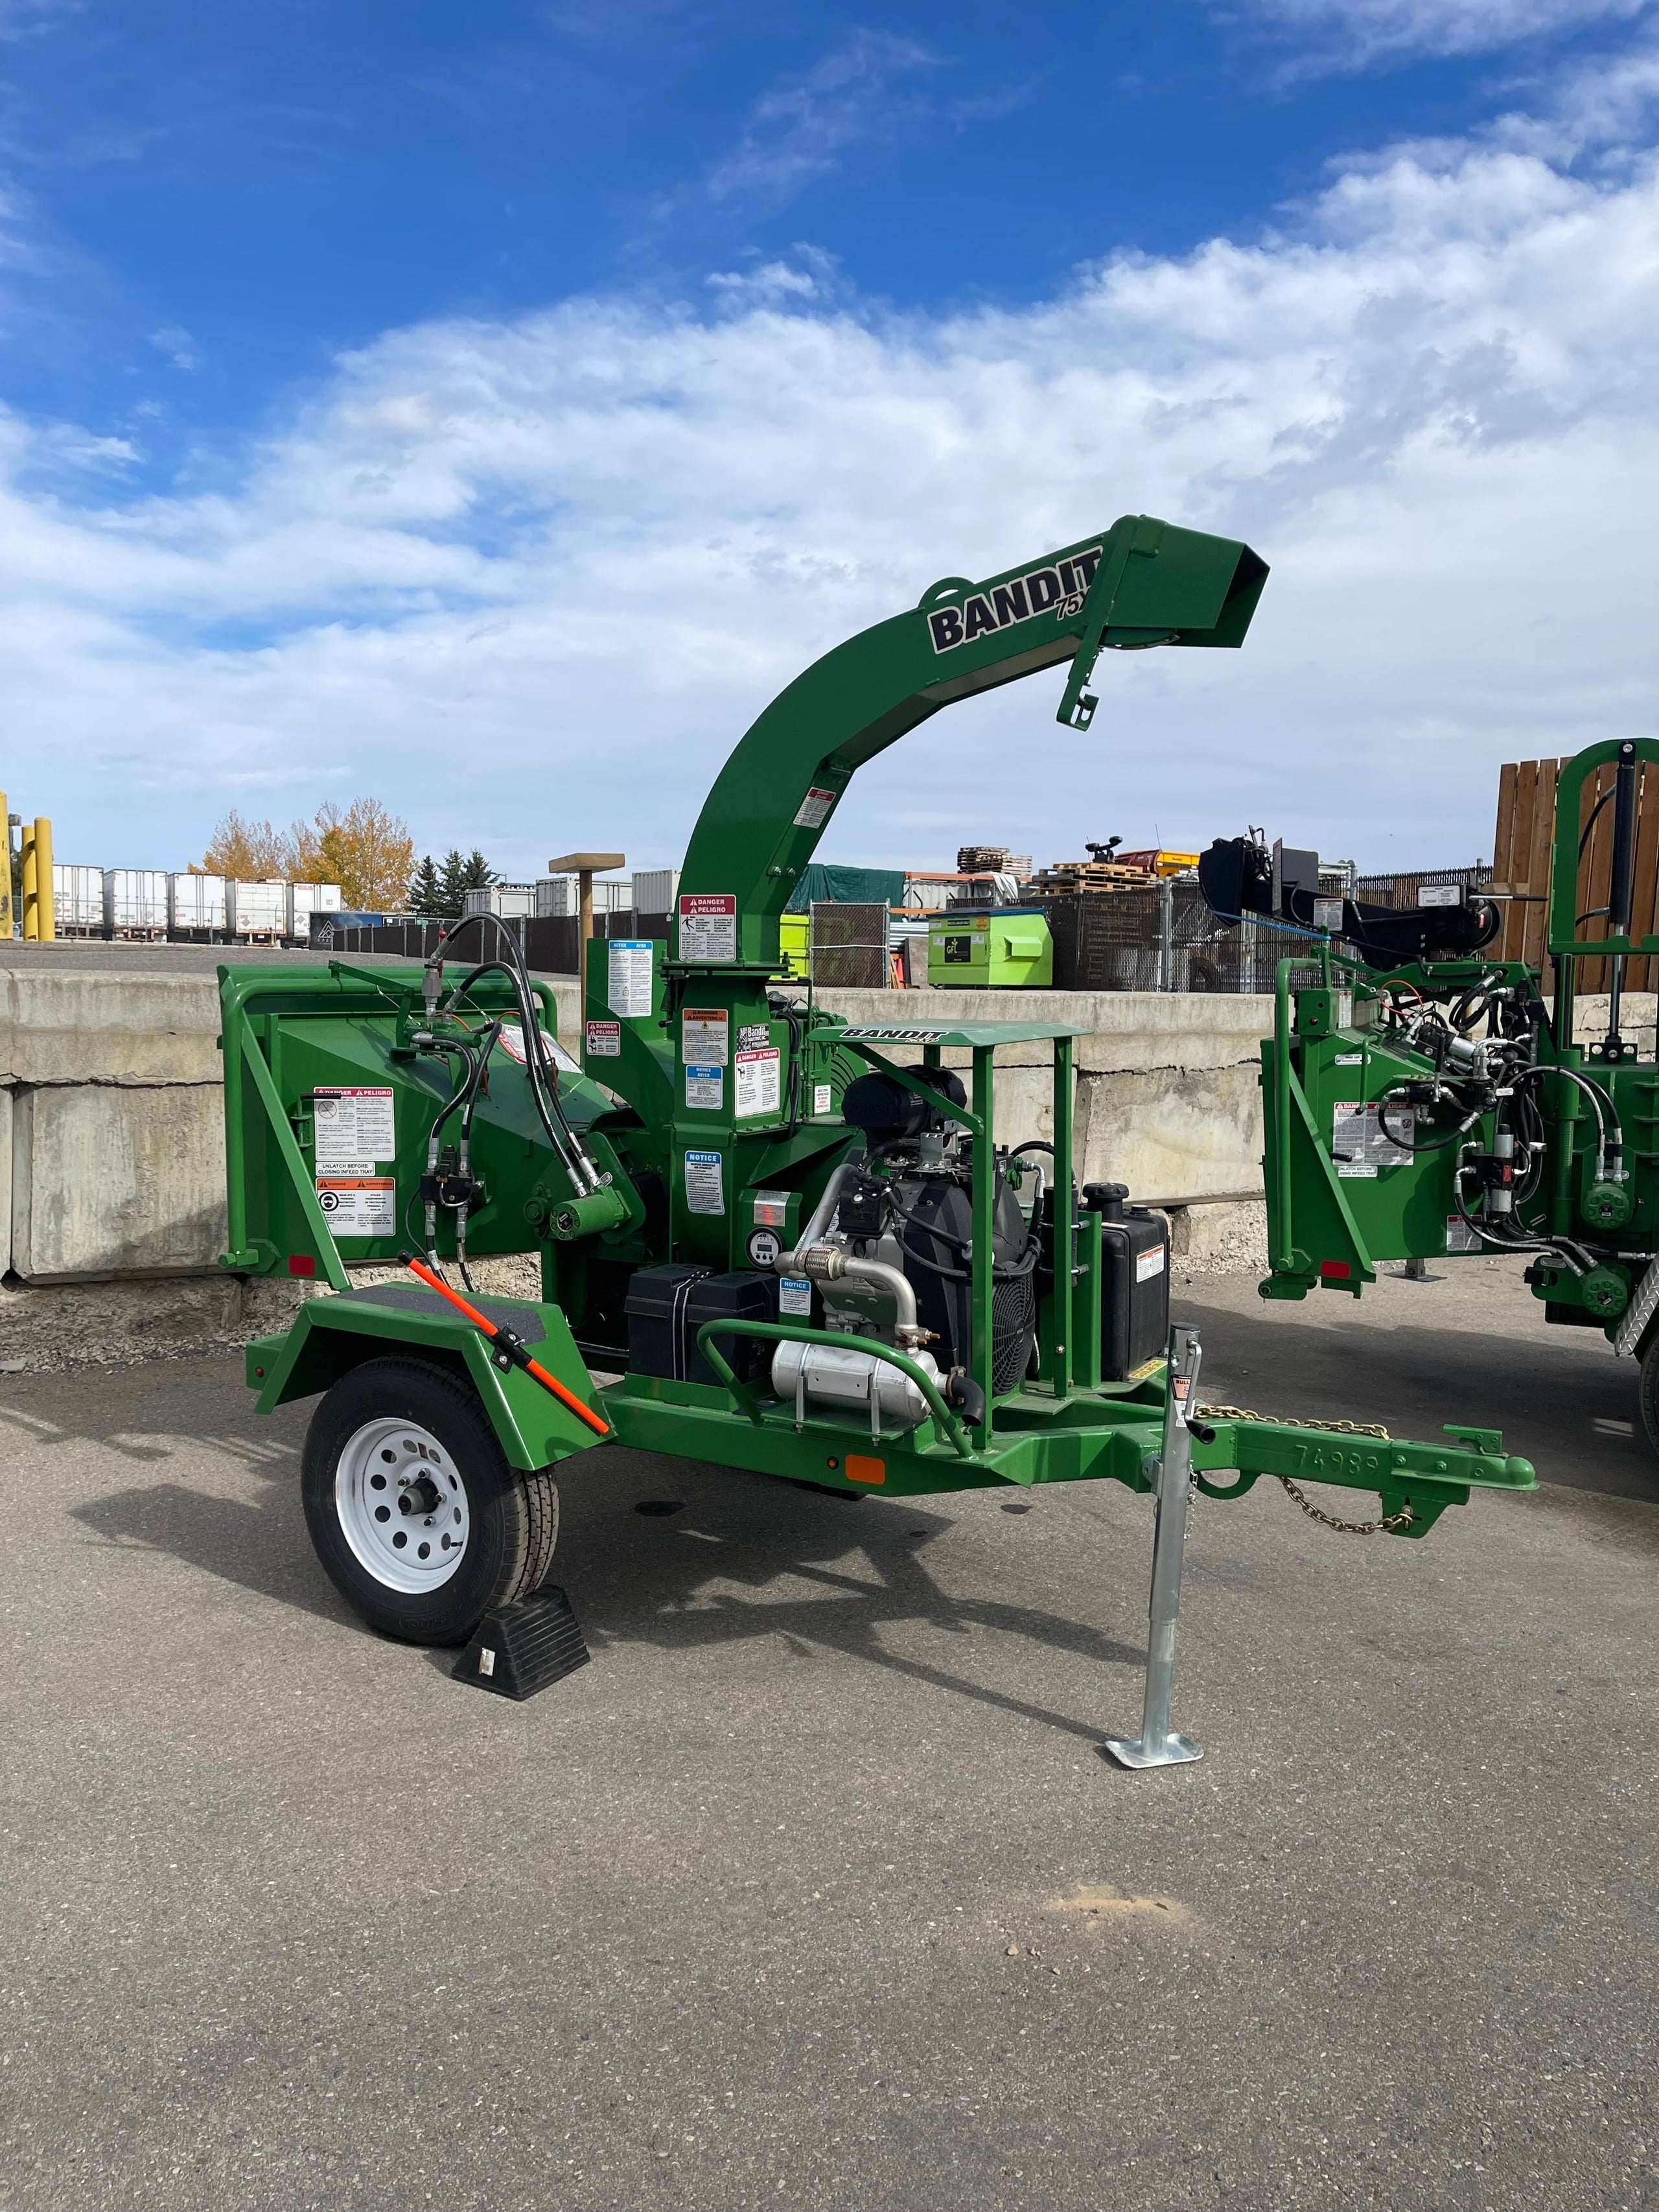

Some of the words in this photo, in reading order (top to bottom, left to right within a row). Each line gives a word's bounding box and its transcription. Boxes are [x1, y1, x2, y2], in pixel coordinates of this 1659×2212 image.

[927, 548, 1102, 653] BANDIT
[1054, 590, 1086, 620] 75X
[946, 944, 958, 954] GFL
[748, 1025, 766, 1037] Bandit
[841, 1029, 948, 1039] BANDIT
